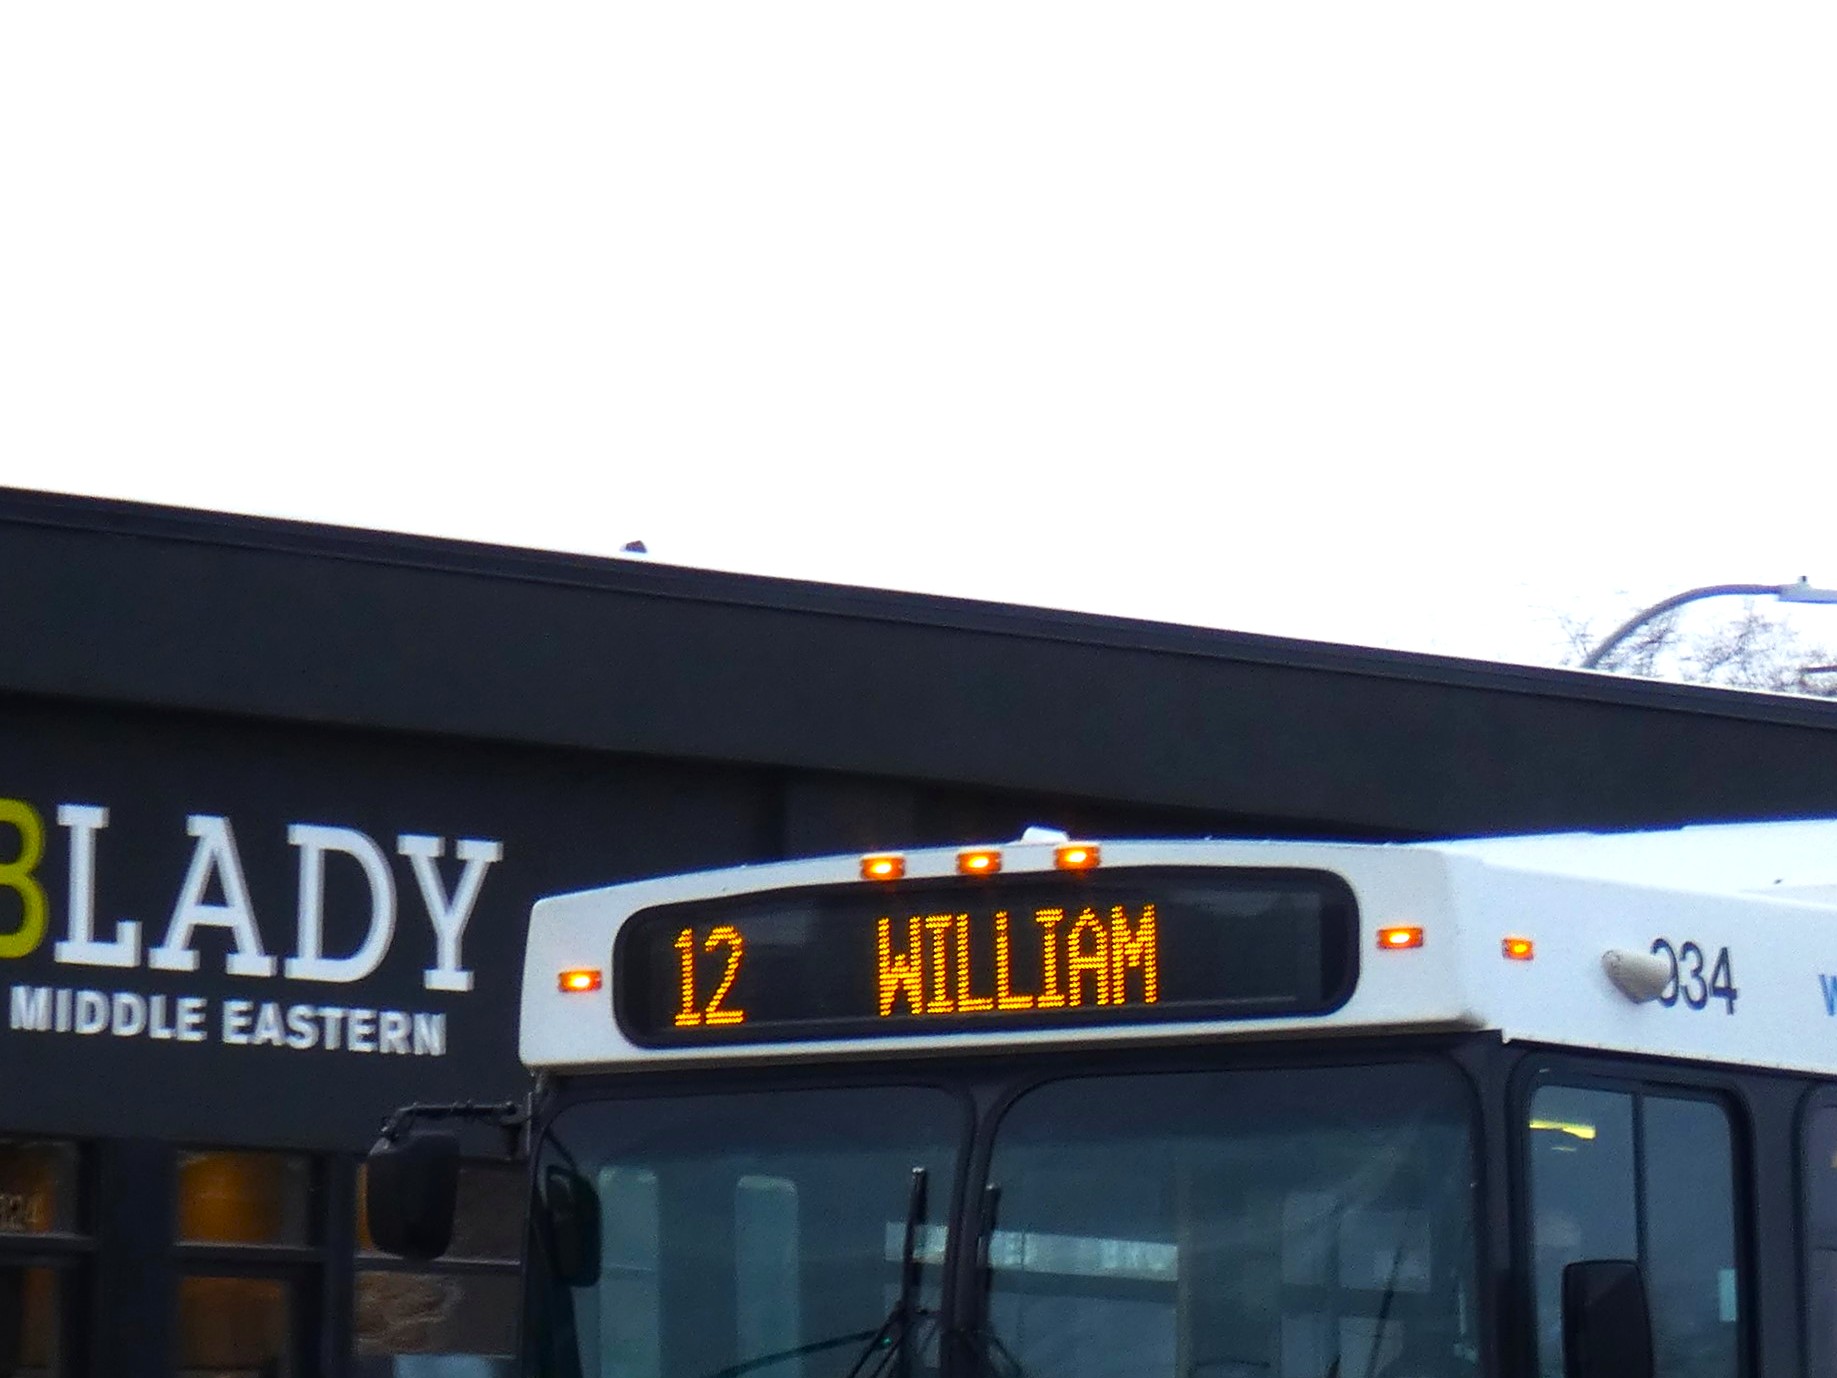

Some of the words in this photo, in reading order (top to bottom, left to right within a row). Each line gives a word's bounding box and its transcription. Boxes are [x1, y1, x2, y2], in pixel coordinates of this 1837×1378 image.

[674, 925, 745, 1027] 12
[878, 904, 1159, 1016] WILLIAM
[10, 985, 207, 1042] MIDDLE
[222, 1000, 446, 1056] EASTERN
